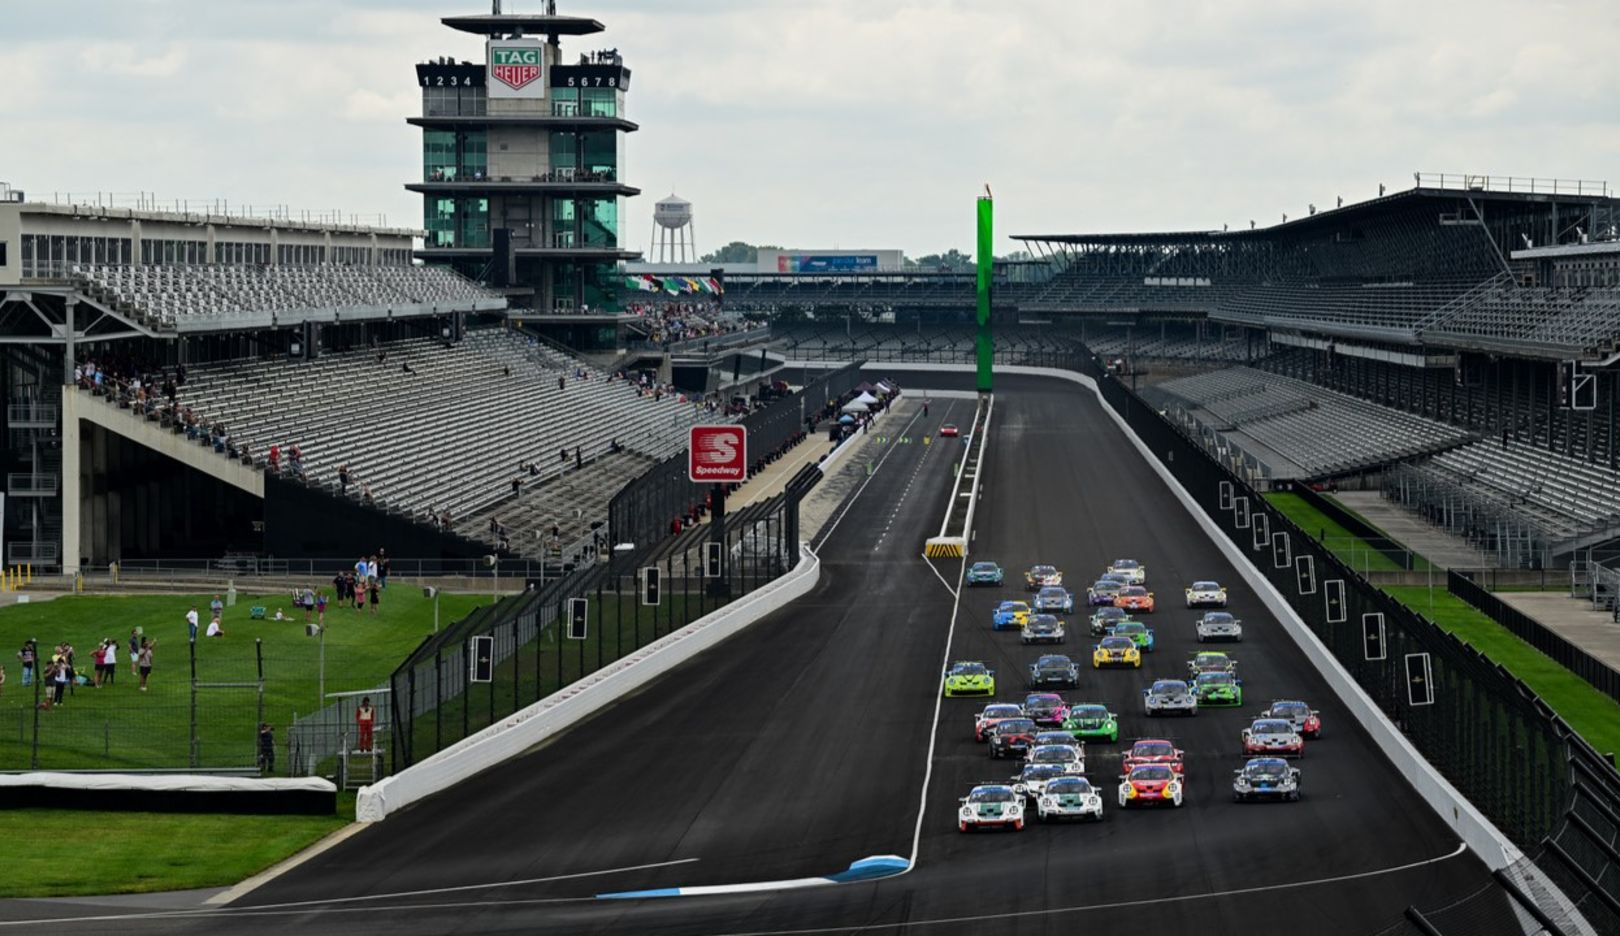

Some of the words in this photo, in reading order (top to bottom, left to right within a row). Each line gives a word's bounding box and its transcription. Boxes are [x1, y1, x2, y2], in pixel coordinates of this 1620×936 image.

[496, 51, 536, 63] TAG
[495, 66, 537, 85] HEUER
[424, 76, 429, 86] 1
[437, 76, 445, 86] 2
[450, 76, 458, 86] 3
[464, 76, 471, 86] 4
[568, 77, 575, 87] 5
[581, 77, 588, 87] 6
[595, 77, 602, 87] 7
[608, 77, 616, 87] 8
[696, 466, 740, 475] Speedway
